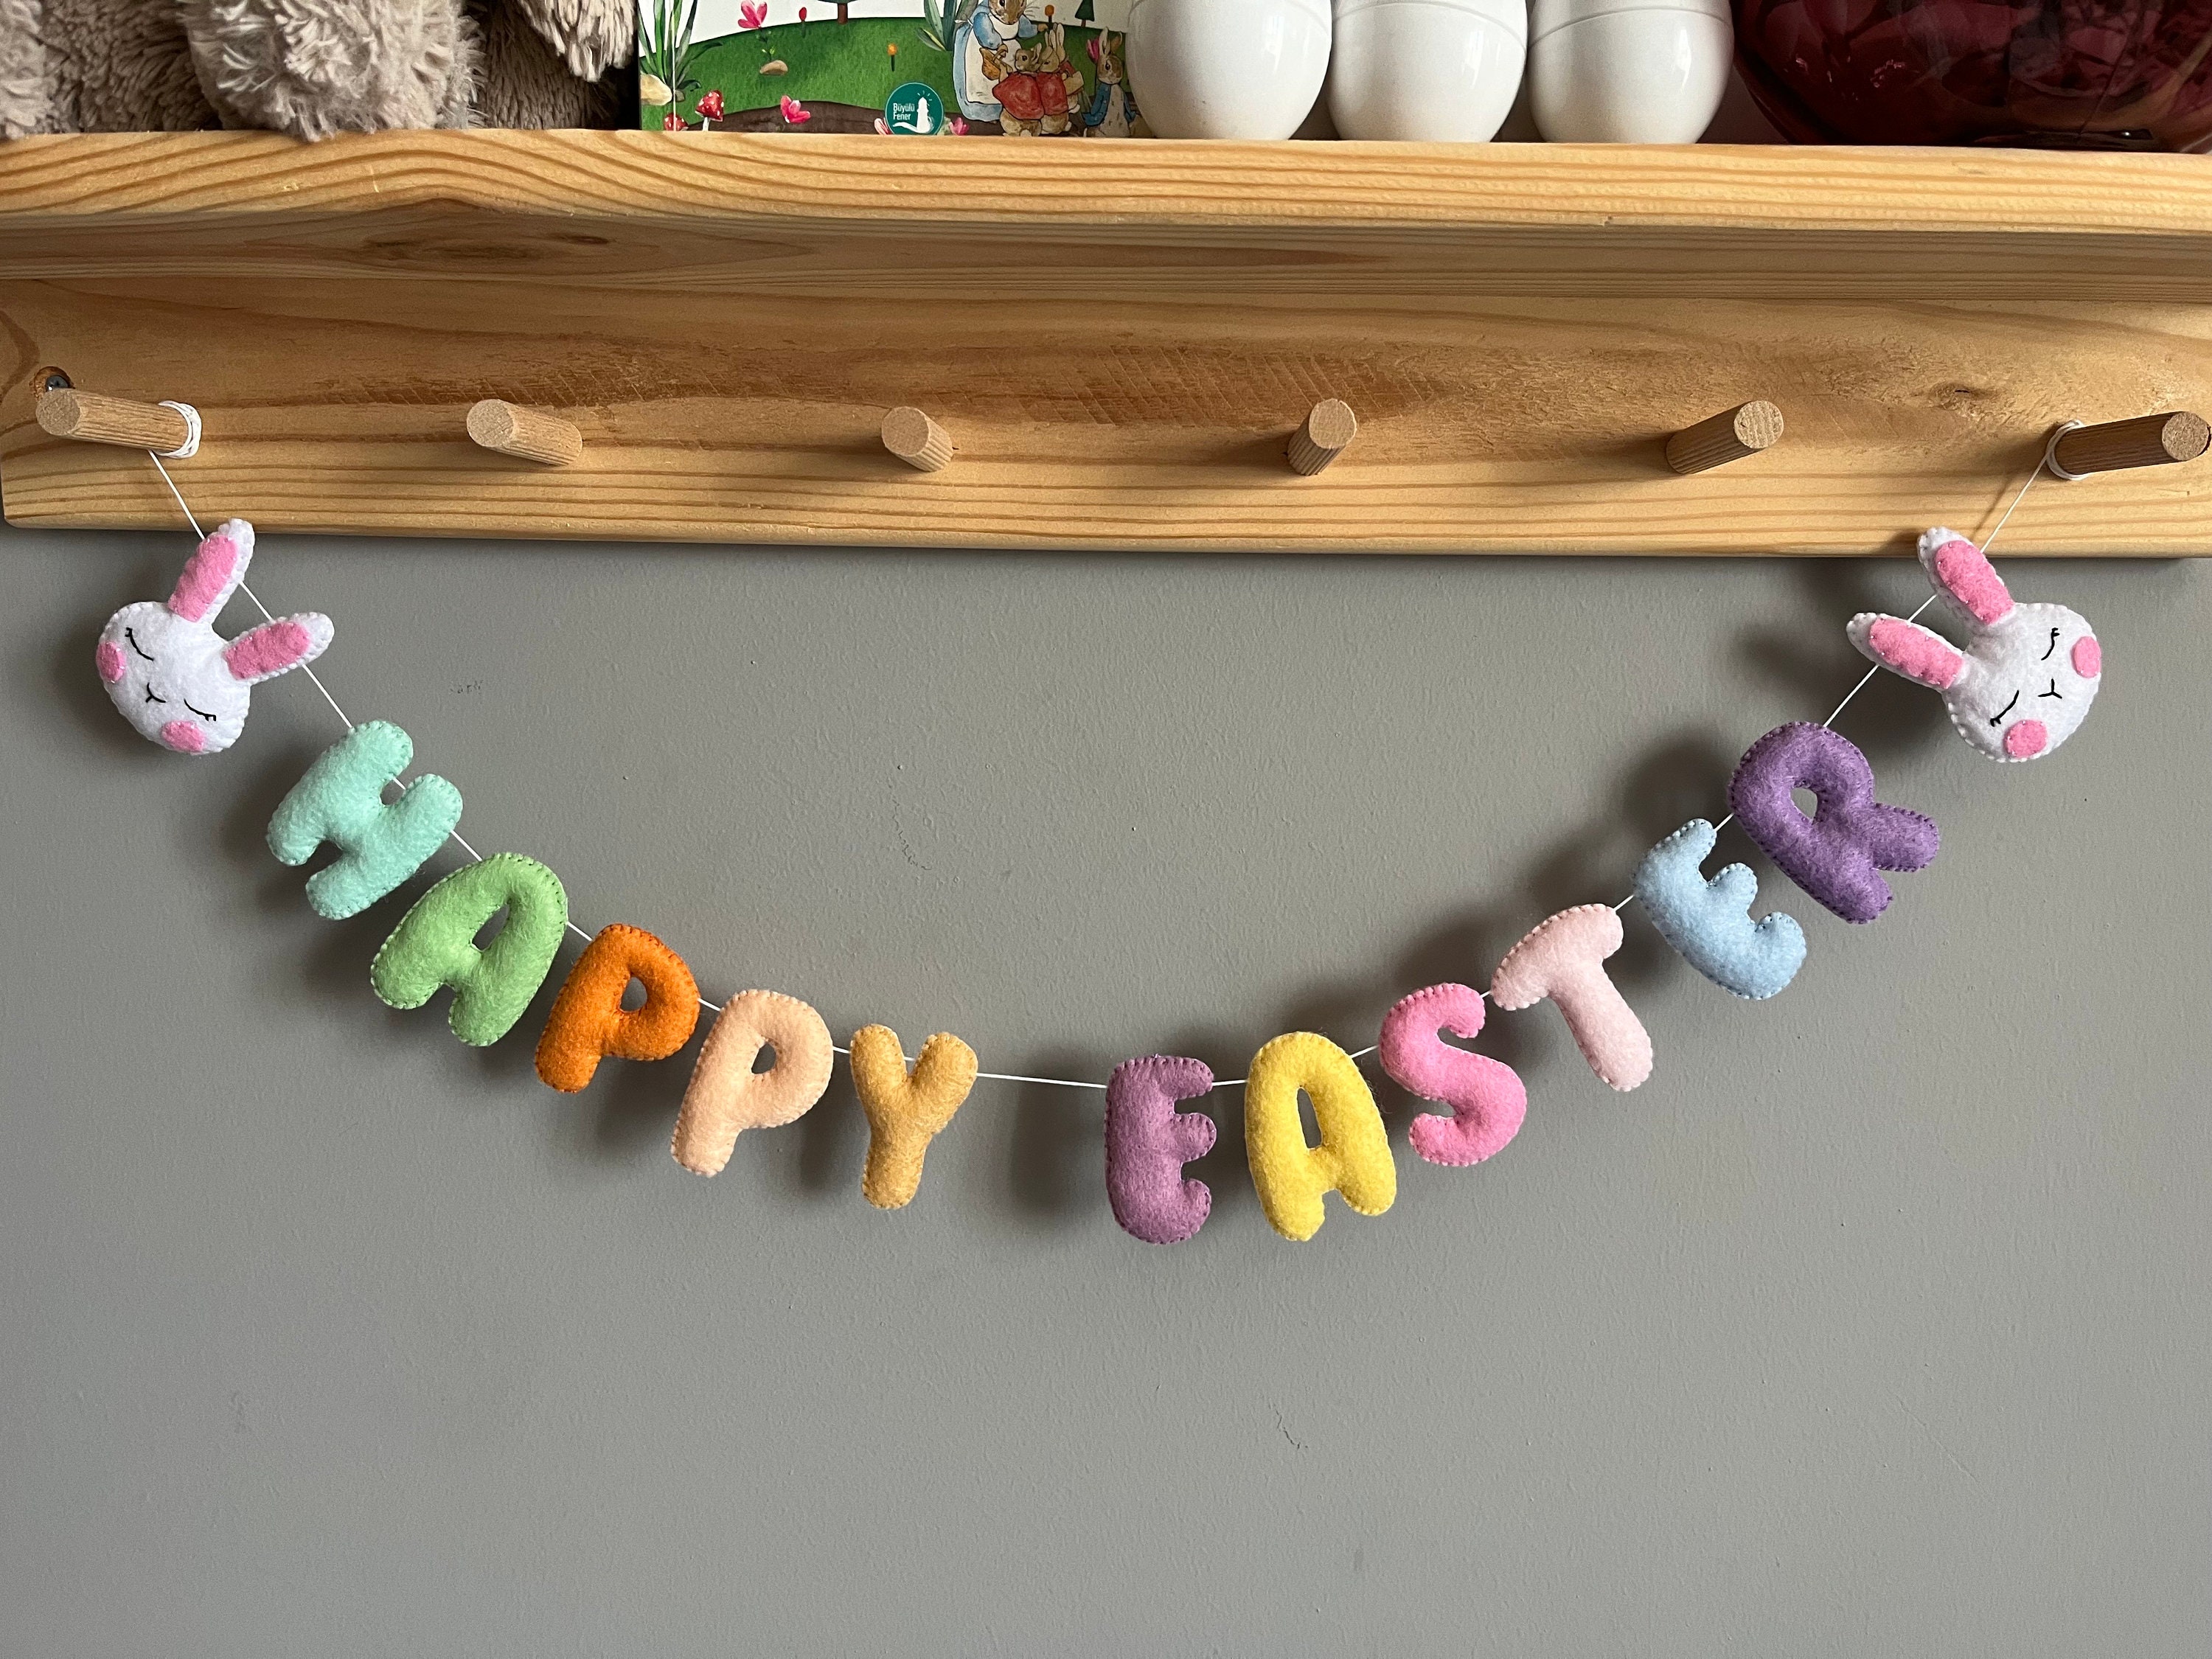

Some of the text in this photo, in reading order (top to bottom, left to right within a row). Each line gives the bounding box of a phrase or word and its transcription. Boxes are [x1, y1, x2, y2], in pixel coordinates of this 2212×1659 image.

[893, 102, 915, 113] Büyülü
[893, 111, 911, 120] Fener
[266, 720, 1941, 1245] HAPPY EASTER
